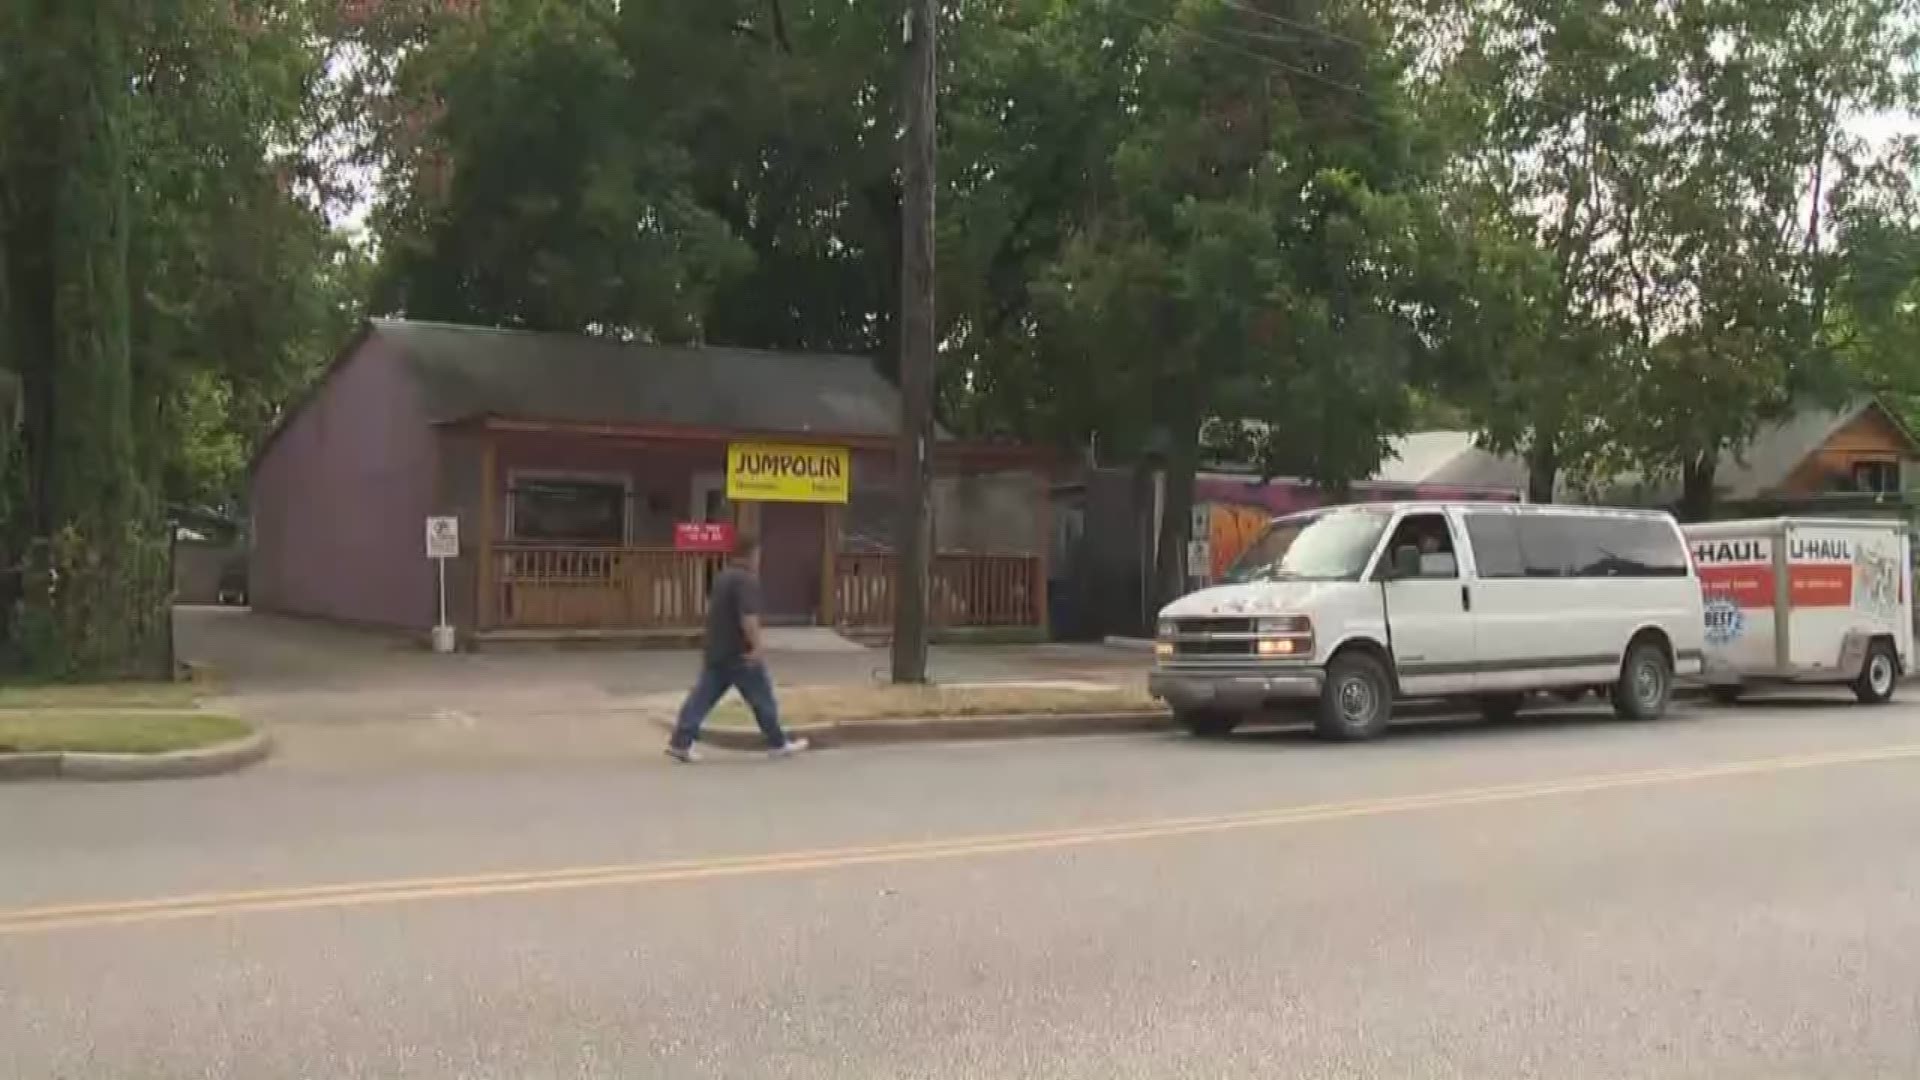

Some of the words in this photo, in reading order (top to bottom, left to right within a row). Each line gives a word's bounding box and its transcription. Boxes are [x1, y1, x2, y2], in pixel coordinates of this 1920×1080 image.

[735, 453, 842, 477] JUMPOLIN
[1694, 541, 1768, 562] -HAUL
[1790, 539, 1850, 559] U-HAUL
